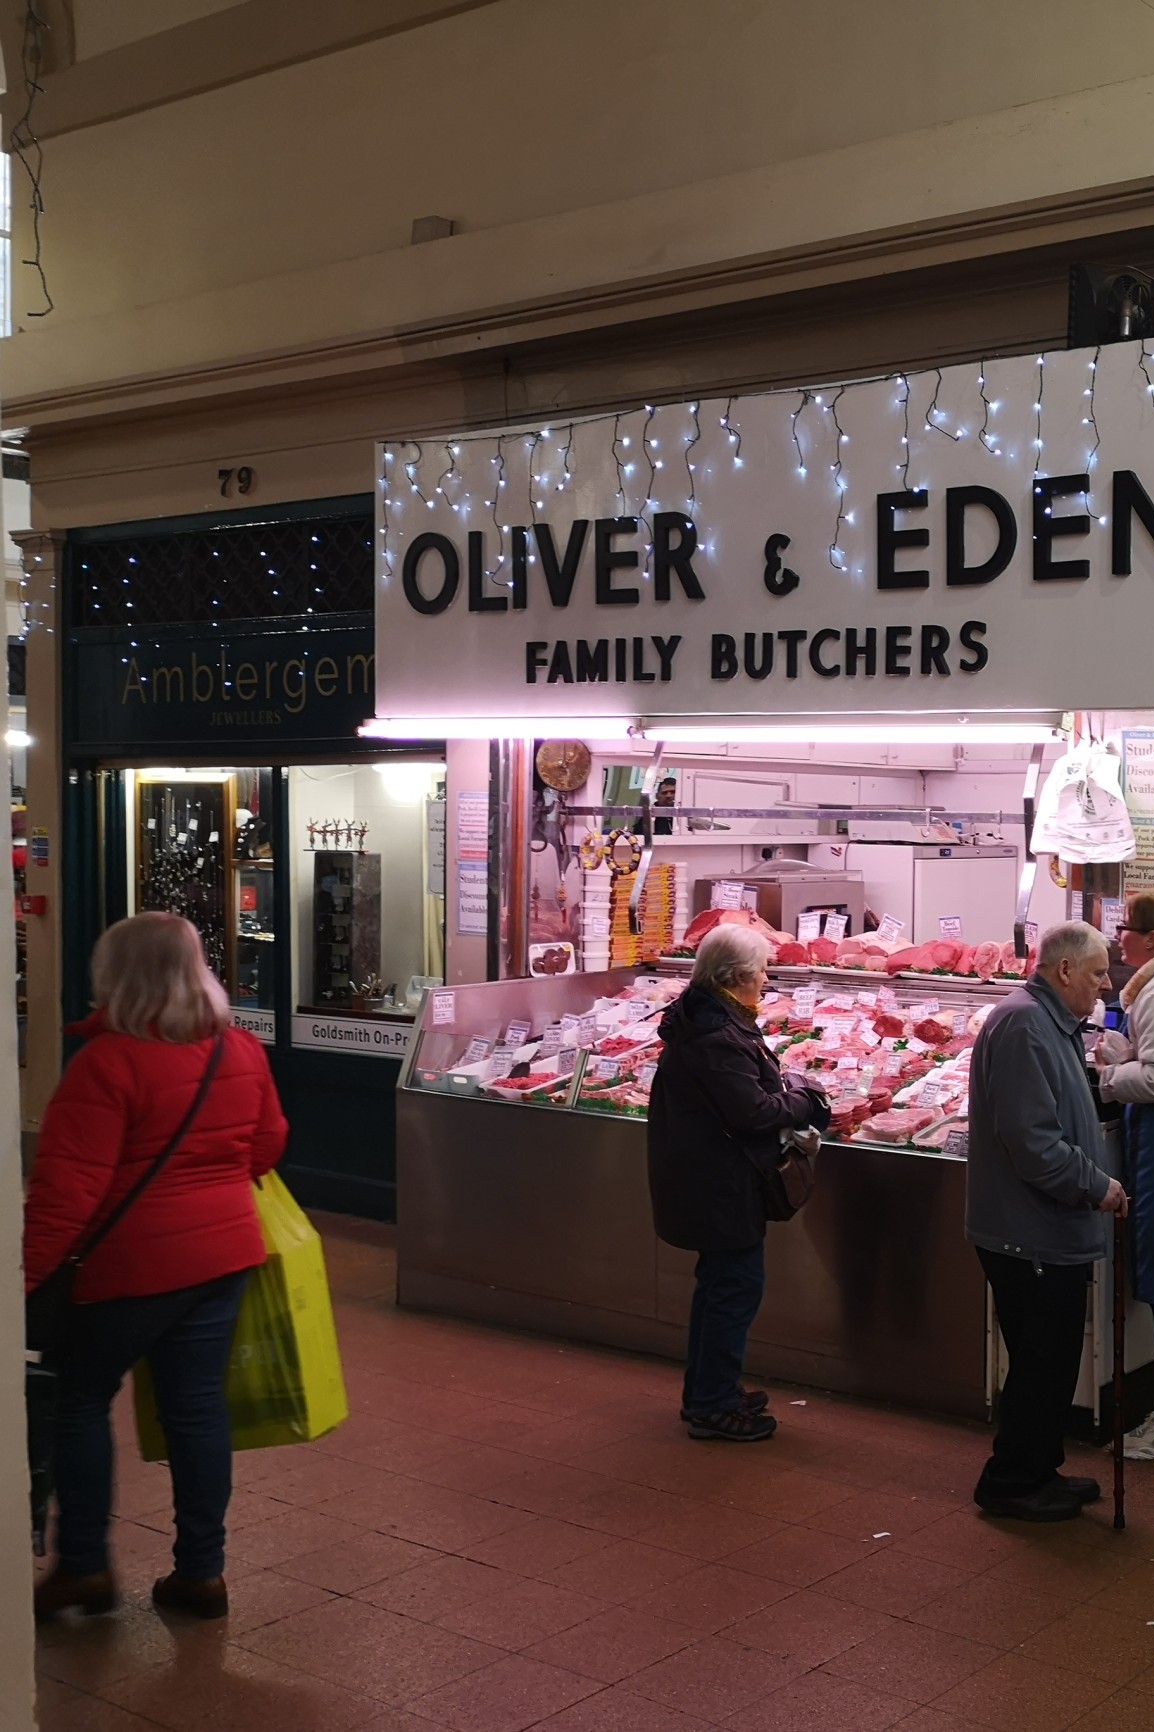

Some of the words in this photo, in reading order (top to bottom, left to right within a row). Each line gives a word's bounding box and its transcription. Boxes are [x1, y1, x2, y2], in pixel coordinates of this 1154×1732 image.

[218, 466, 254, 497] 79
[403, 511, 706, 615] OLIVER
[764, 533, 800, 596] &
[526, 635, 682, 684] FAMILY
[711, 620, 989, 680] BUTCHERS
[121, 650, 375, 713] Amblergem
[209, 710, 282, 726] JEWELLERS
[1123, 871, 1141, 879] Local
[234, 1016, 273, 1033] Repairs
[312, 1024, 371, 1043] Goldsmith
[374, 1031, 410, 1047] On-Pr
